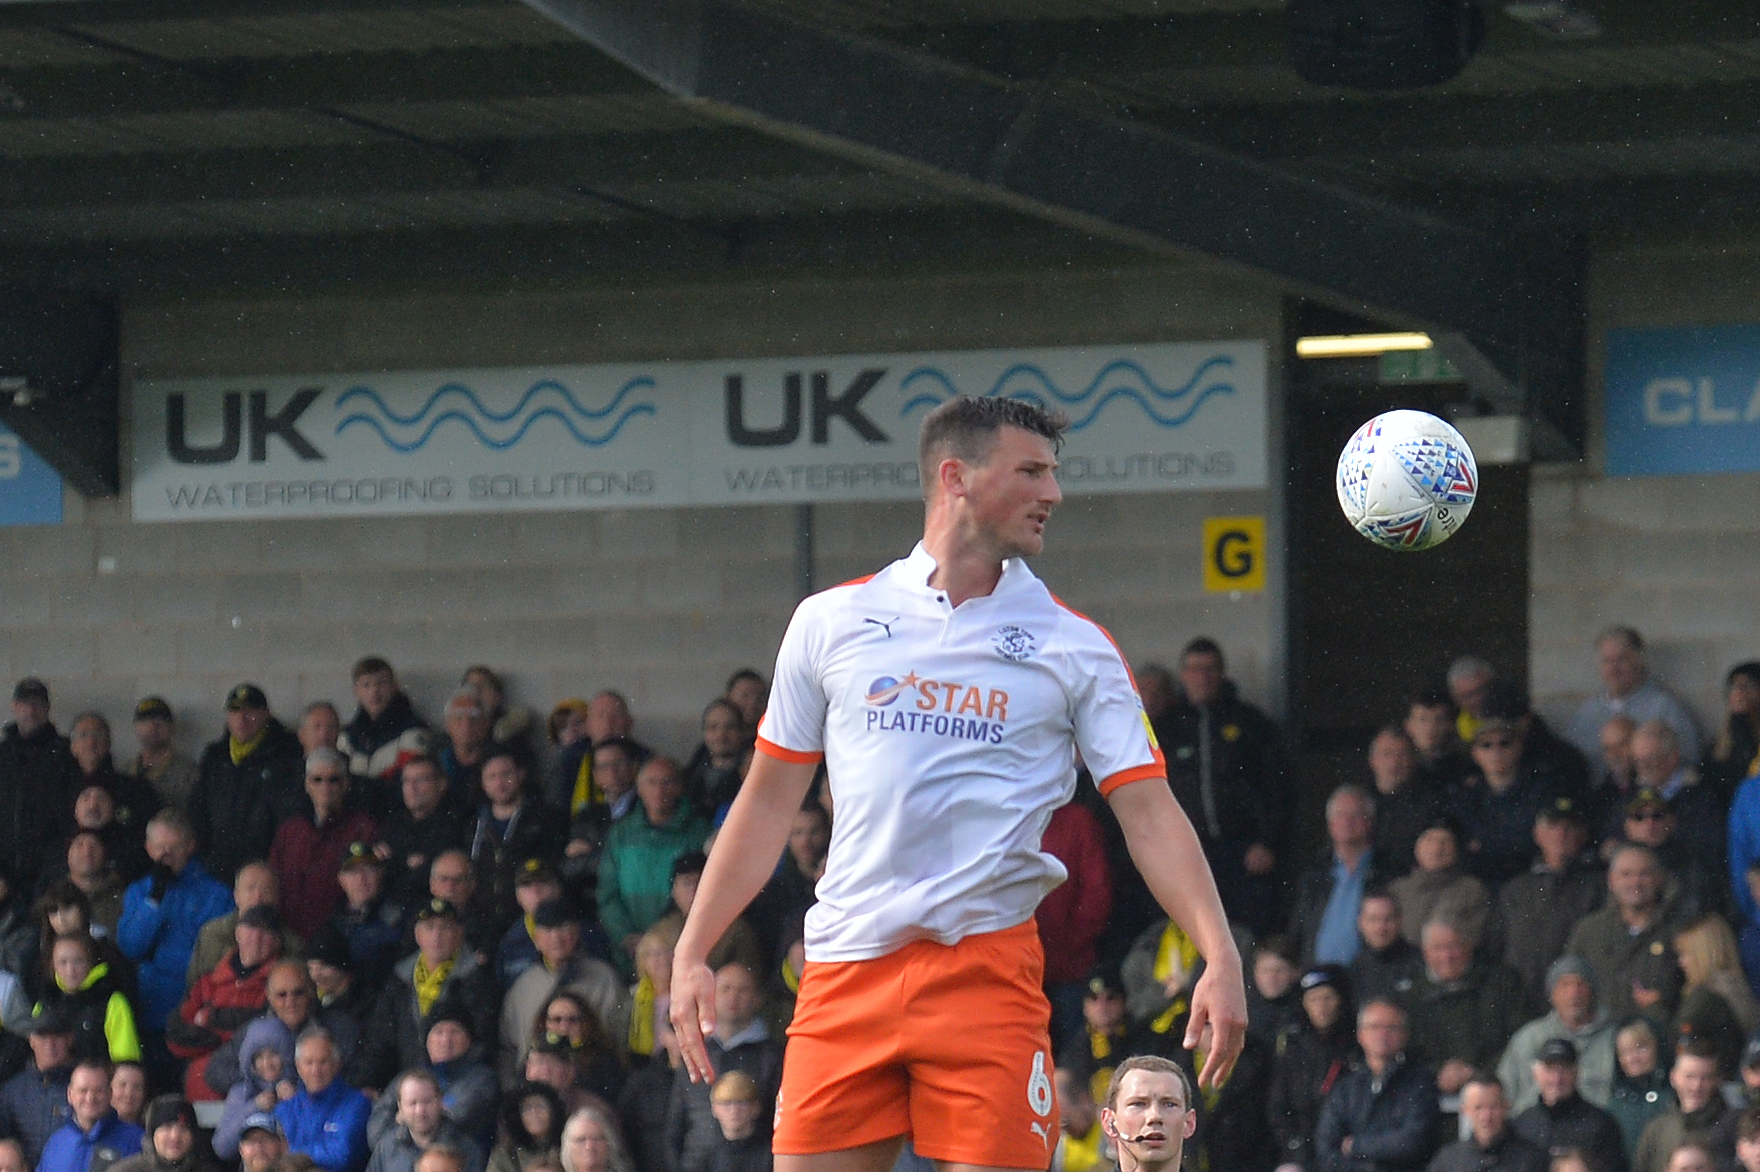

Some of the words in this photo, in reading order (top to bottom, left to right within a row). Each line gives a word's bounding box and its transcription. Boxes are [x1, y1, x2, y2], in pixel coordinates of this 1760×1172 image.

[165, 386, 326, 465] UK
[724, 370, 889, 447] UK
[167, 475, 452, 511] WATERPROOFING
[467, 469, 655, 498] SOLUTIONS
[1213, 529, 1253, 578] G
[916, 676, 1009, 722] STAR
[866, 709, 1004, 744] PLATFORMS
[1027, 1051, 1053, 1117] 6
